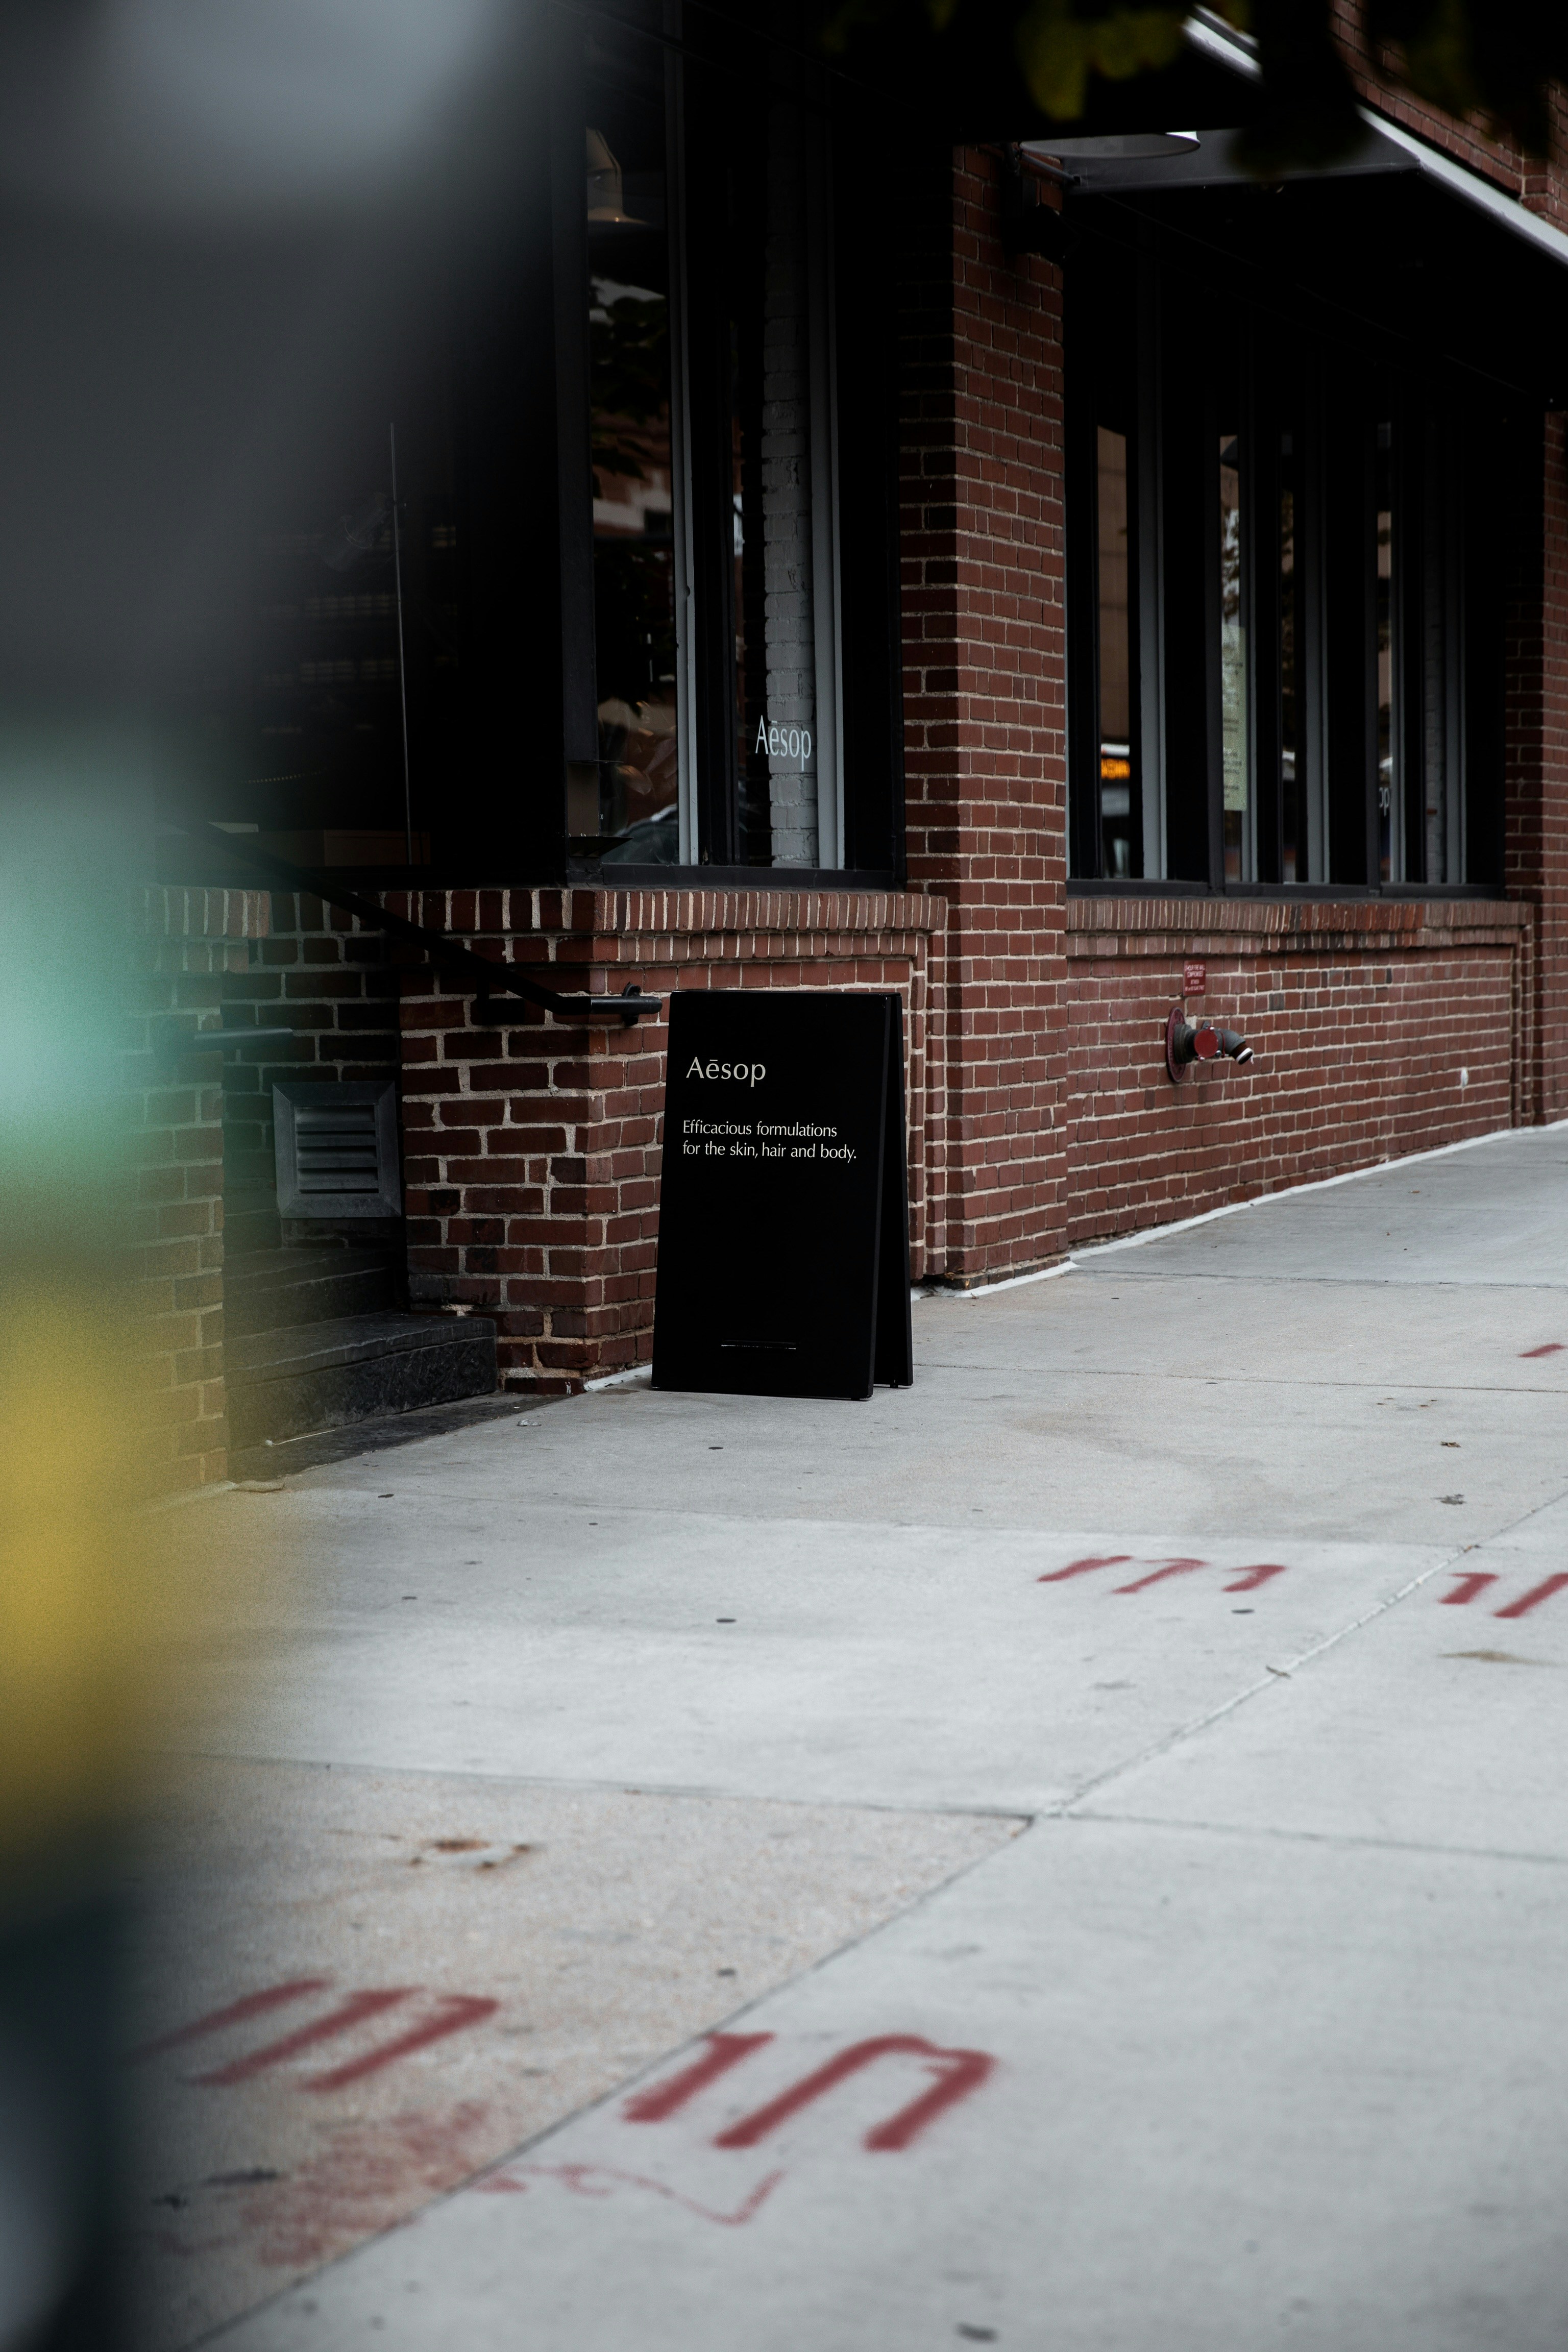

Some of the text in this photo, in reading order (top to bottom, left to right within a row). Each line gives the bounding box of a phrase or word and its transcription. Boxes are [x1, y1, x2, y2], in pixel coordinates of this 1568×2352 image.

[755, 715, 812, 772] Aēsop
[685, 1057, 766, 1087] Aēsop
[683, 1119, 837, 1137] Efficacious formulations
[682, 1140, 856, 1163] for the skin, hair and body.
